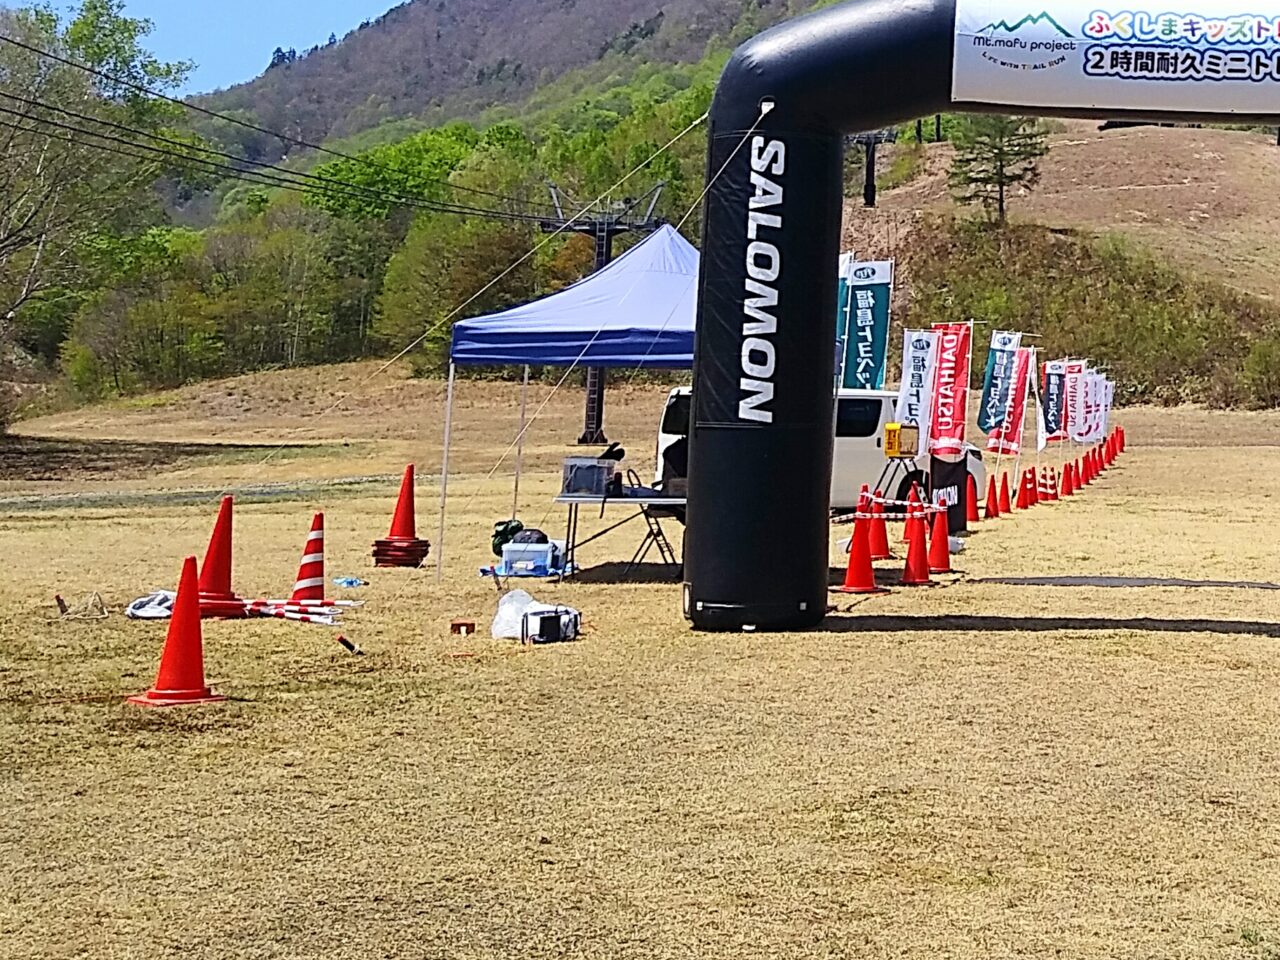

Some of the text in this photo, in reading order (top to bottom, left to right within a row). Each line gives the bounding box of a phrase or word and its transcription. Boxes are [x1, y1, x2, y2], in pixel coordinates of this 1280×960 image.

[1030, 40, 1077, 52] project
[982, 51, 998, 64] LFE
[738, 135, 785, 424] SALOMON
